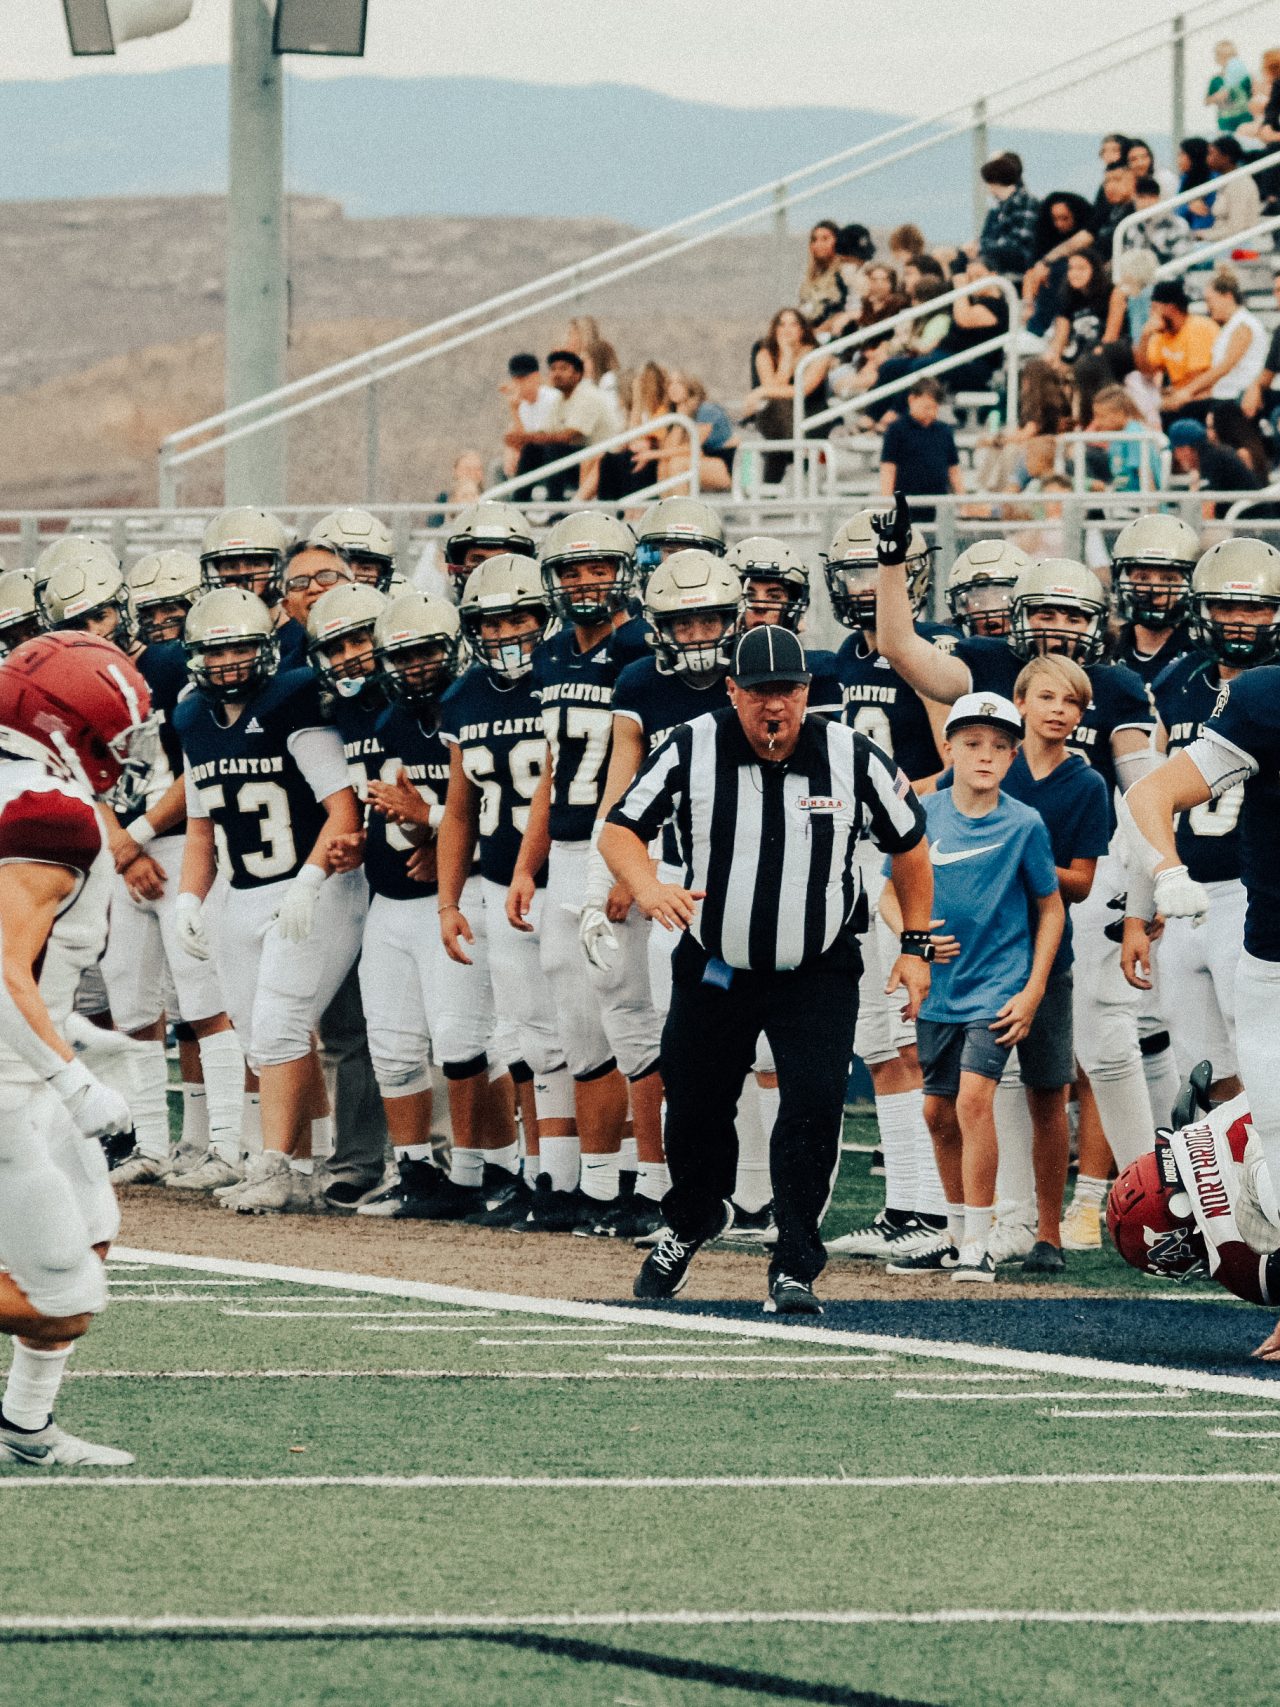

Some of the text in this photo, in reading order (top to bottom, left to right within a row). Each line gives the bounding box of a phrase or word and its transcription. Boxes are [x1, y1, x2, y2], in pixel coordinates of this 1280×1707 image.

[561, 683, 613, 704] CANYON
[849, 684, 897, 704] CANYON
[493, 716, 543, 735] CANYO
[219, 756, 283, 775] CANYON
